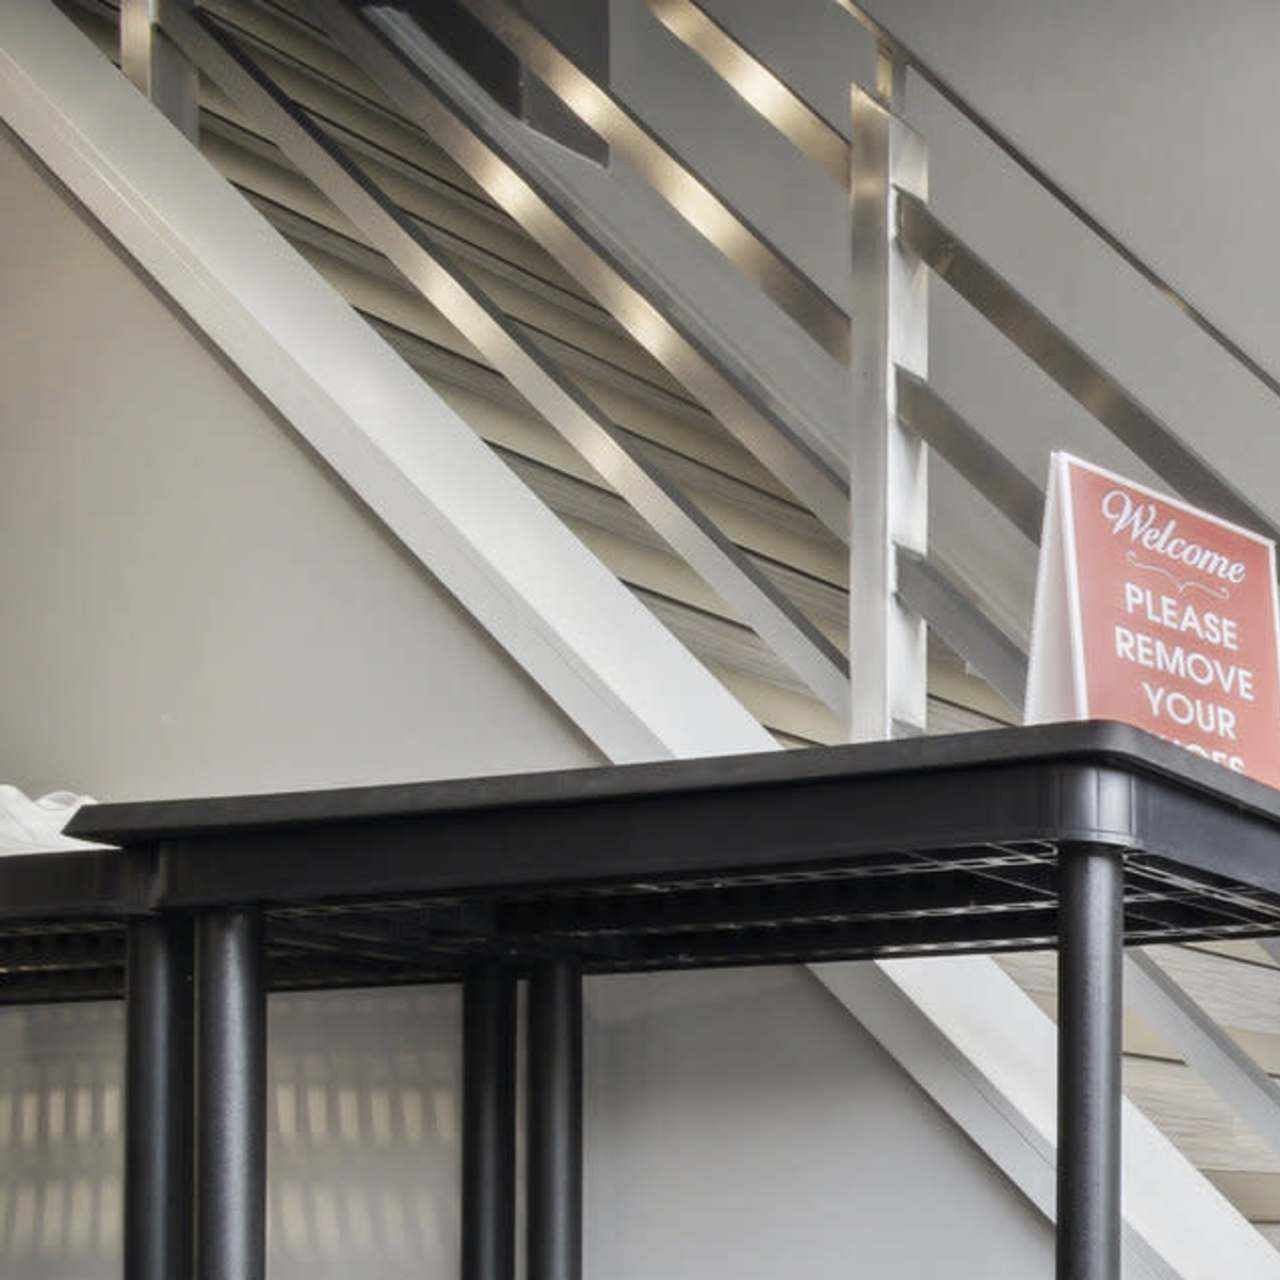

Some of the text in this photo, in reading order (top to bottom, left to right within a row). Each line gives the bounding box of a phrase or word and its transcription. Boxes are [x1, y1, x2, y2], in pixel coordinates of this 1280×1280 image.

[1101, 489, 1246, 584] Welcome
[1124, 582, 1239, 651] PLEASE
[1114, 625, 1255, 701] REMOVE
[1141, 682, 1237, 741] YOUR
